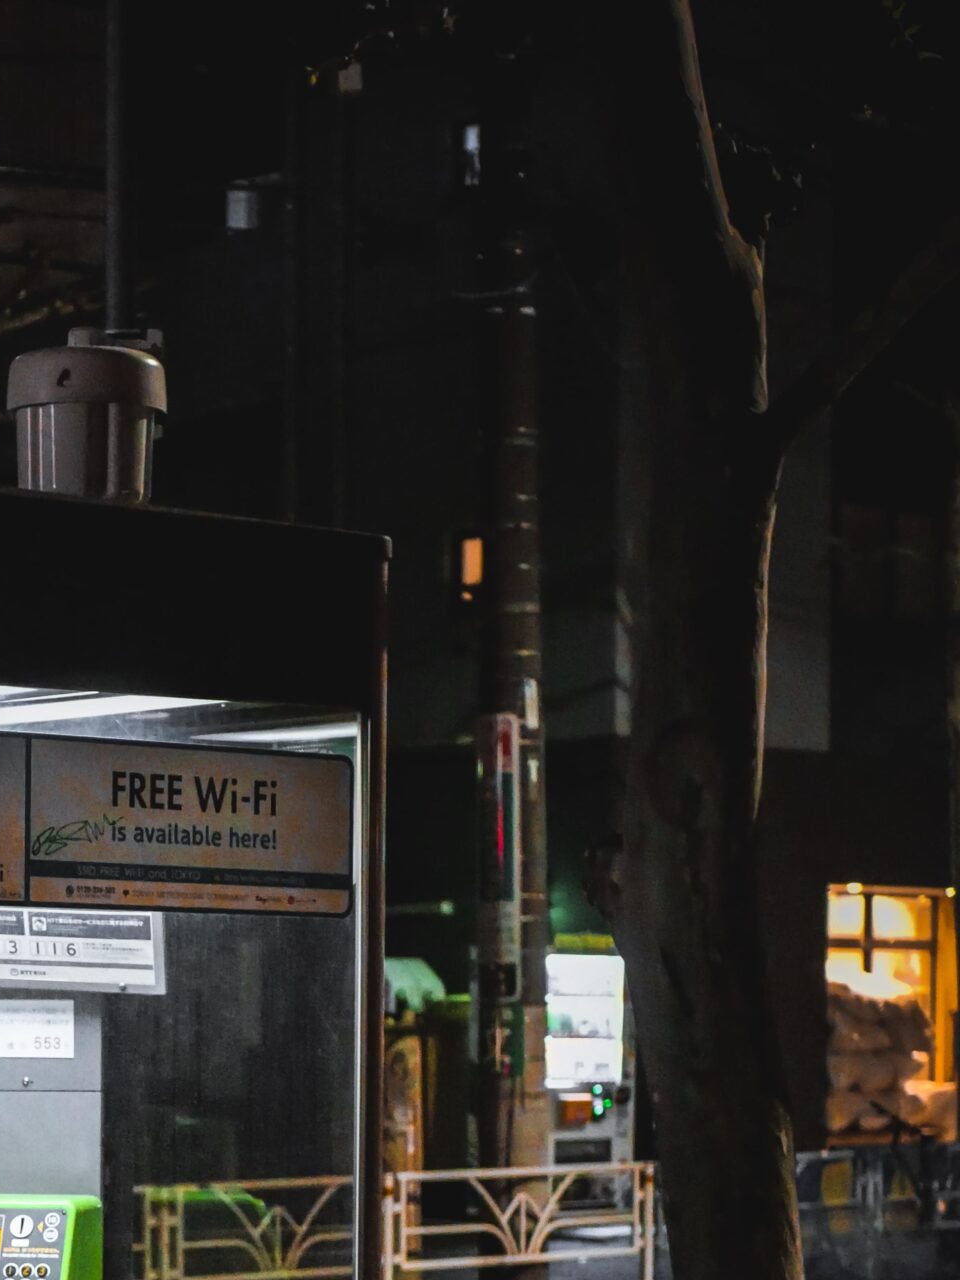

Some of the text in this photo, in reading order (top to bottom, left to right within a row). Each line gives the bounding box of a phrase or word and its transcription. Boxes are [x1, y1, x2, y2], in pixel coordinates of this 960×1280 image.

[111, 770, 278, 817] FREE Wi-Fi
[111, 822, 127, 842] is
[134, 826, 222, 847] available
[228, 829, 278, 850] here!
[36, 942, 77, 957] 116
[33, 1036, 62, 1051] 553
